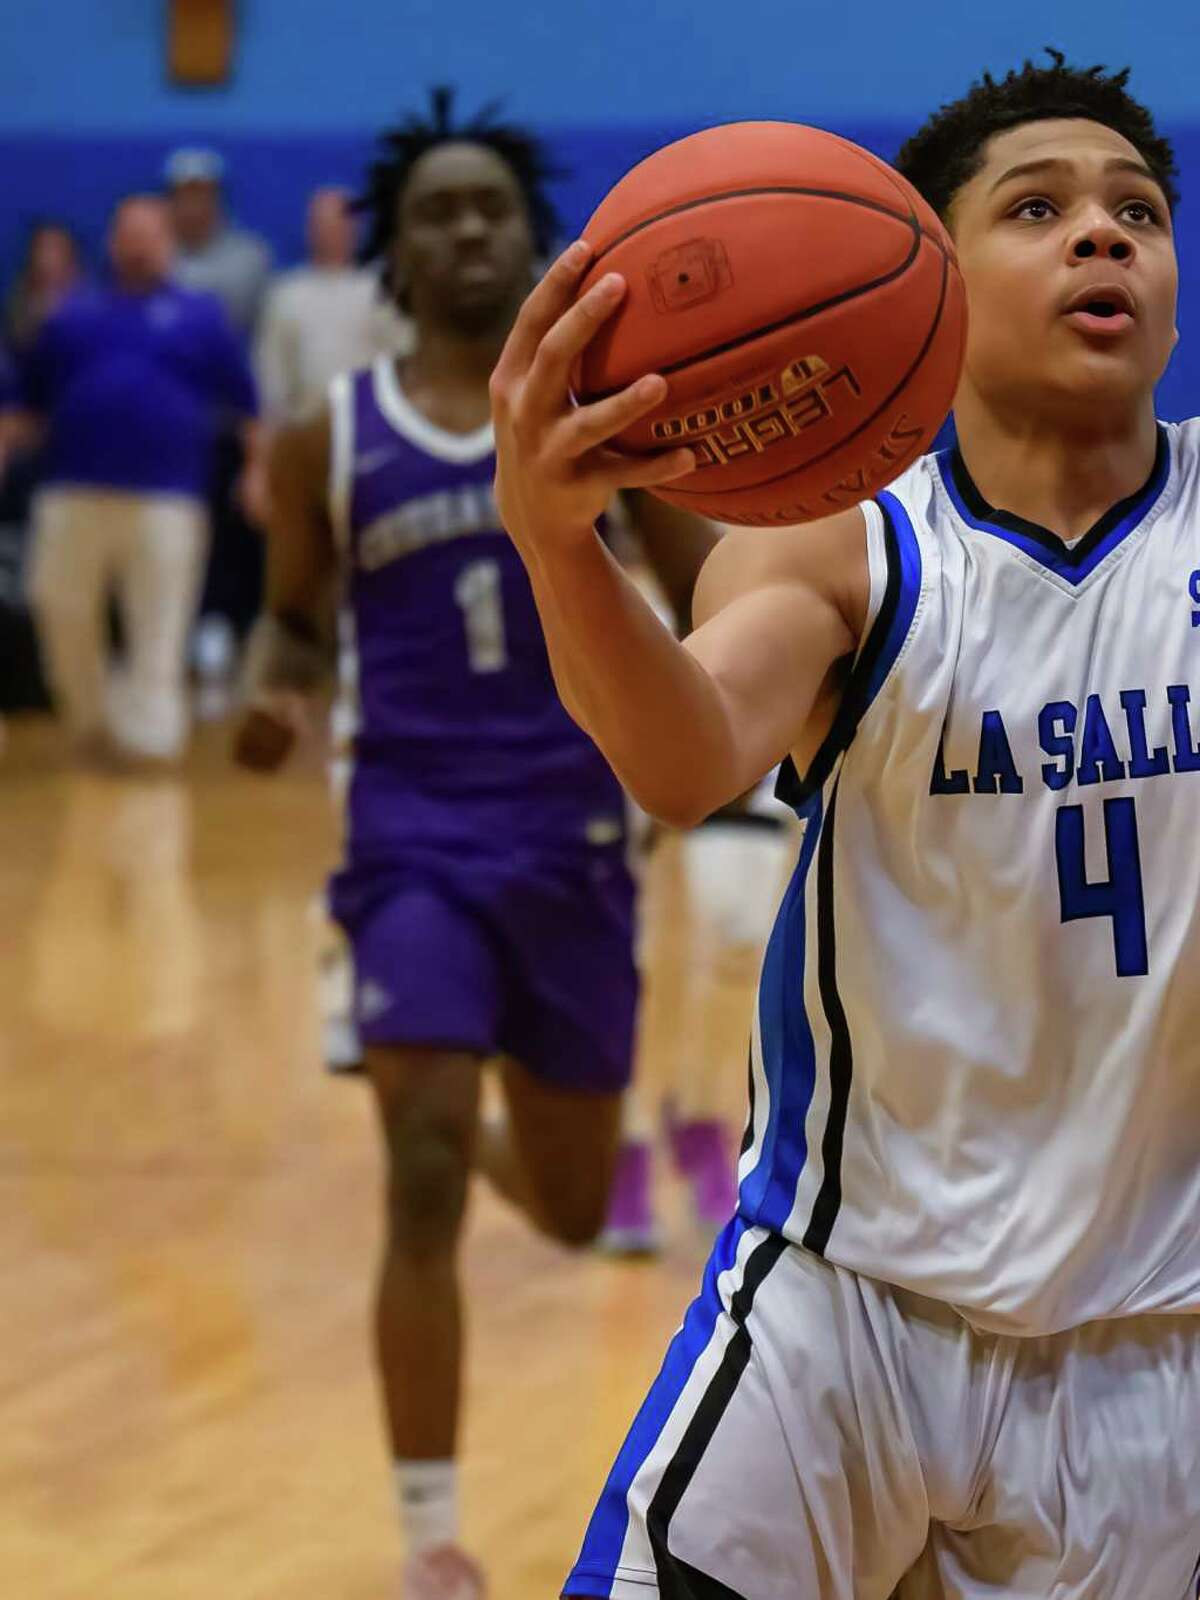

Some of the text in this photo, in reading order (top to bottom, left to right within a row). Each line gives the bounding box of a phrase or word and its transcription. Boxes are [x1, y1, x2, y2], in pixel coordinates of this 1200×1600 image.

[697, 364, 862, 465] LEGAC
[455, 558, 507, 674] 1
[929, 710, 1024, 796] LA
[1056, 797, 1149, 978] 4
